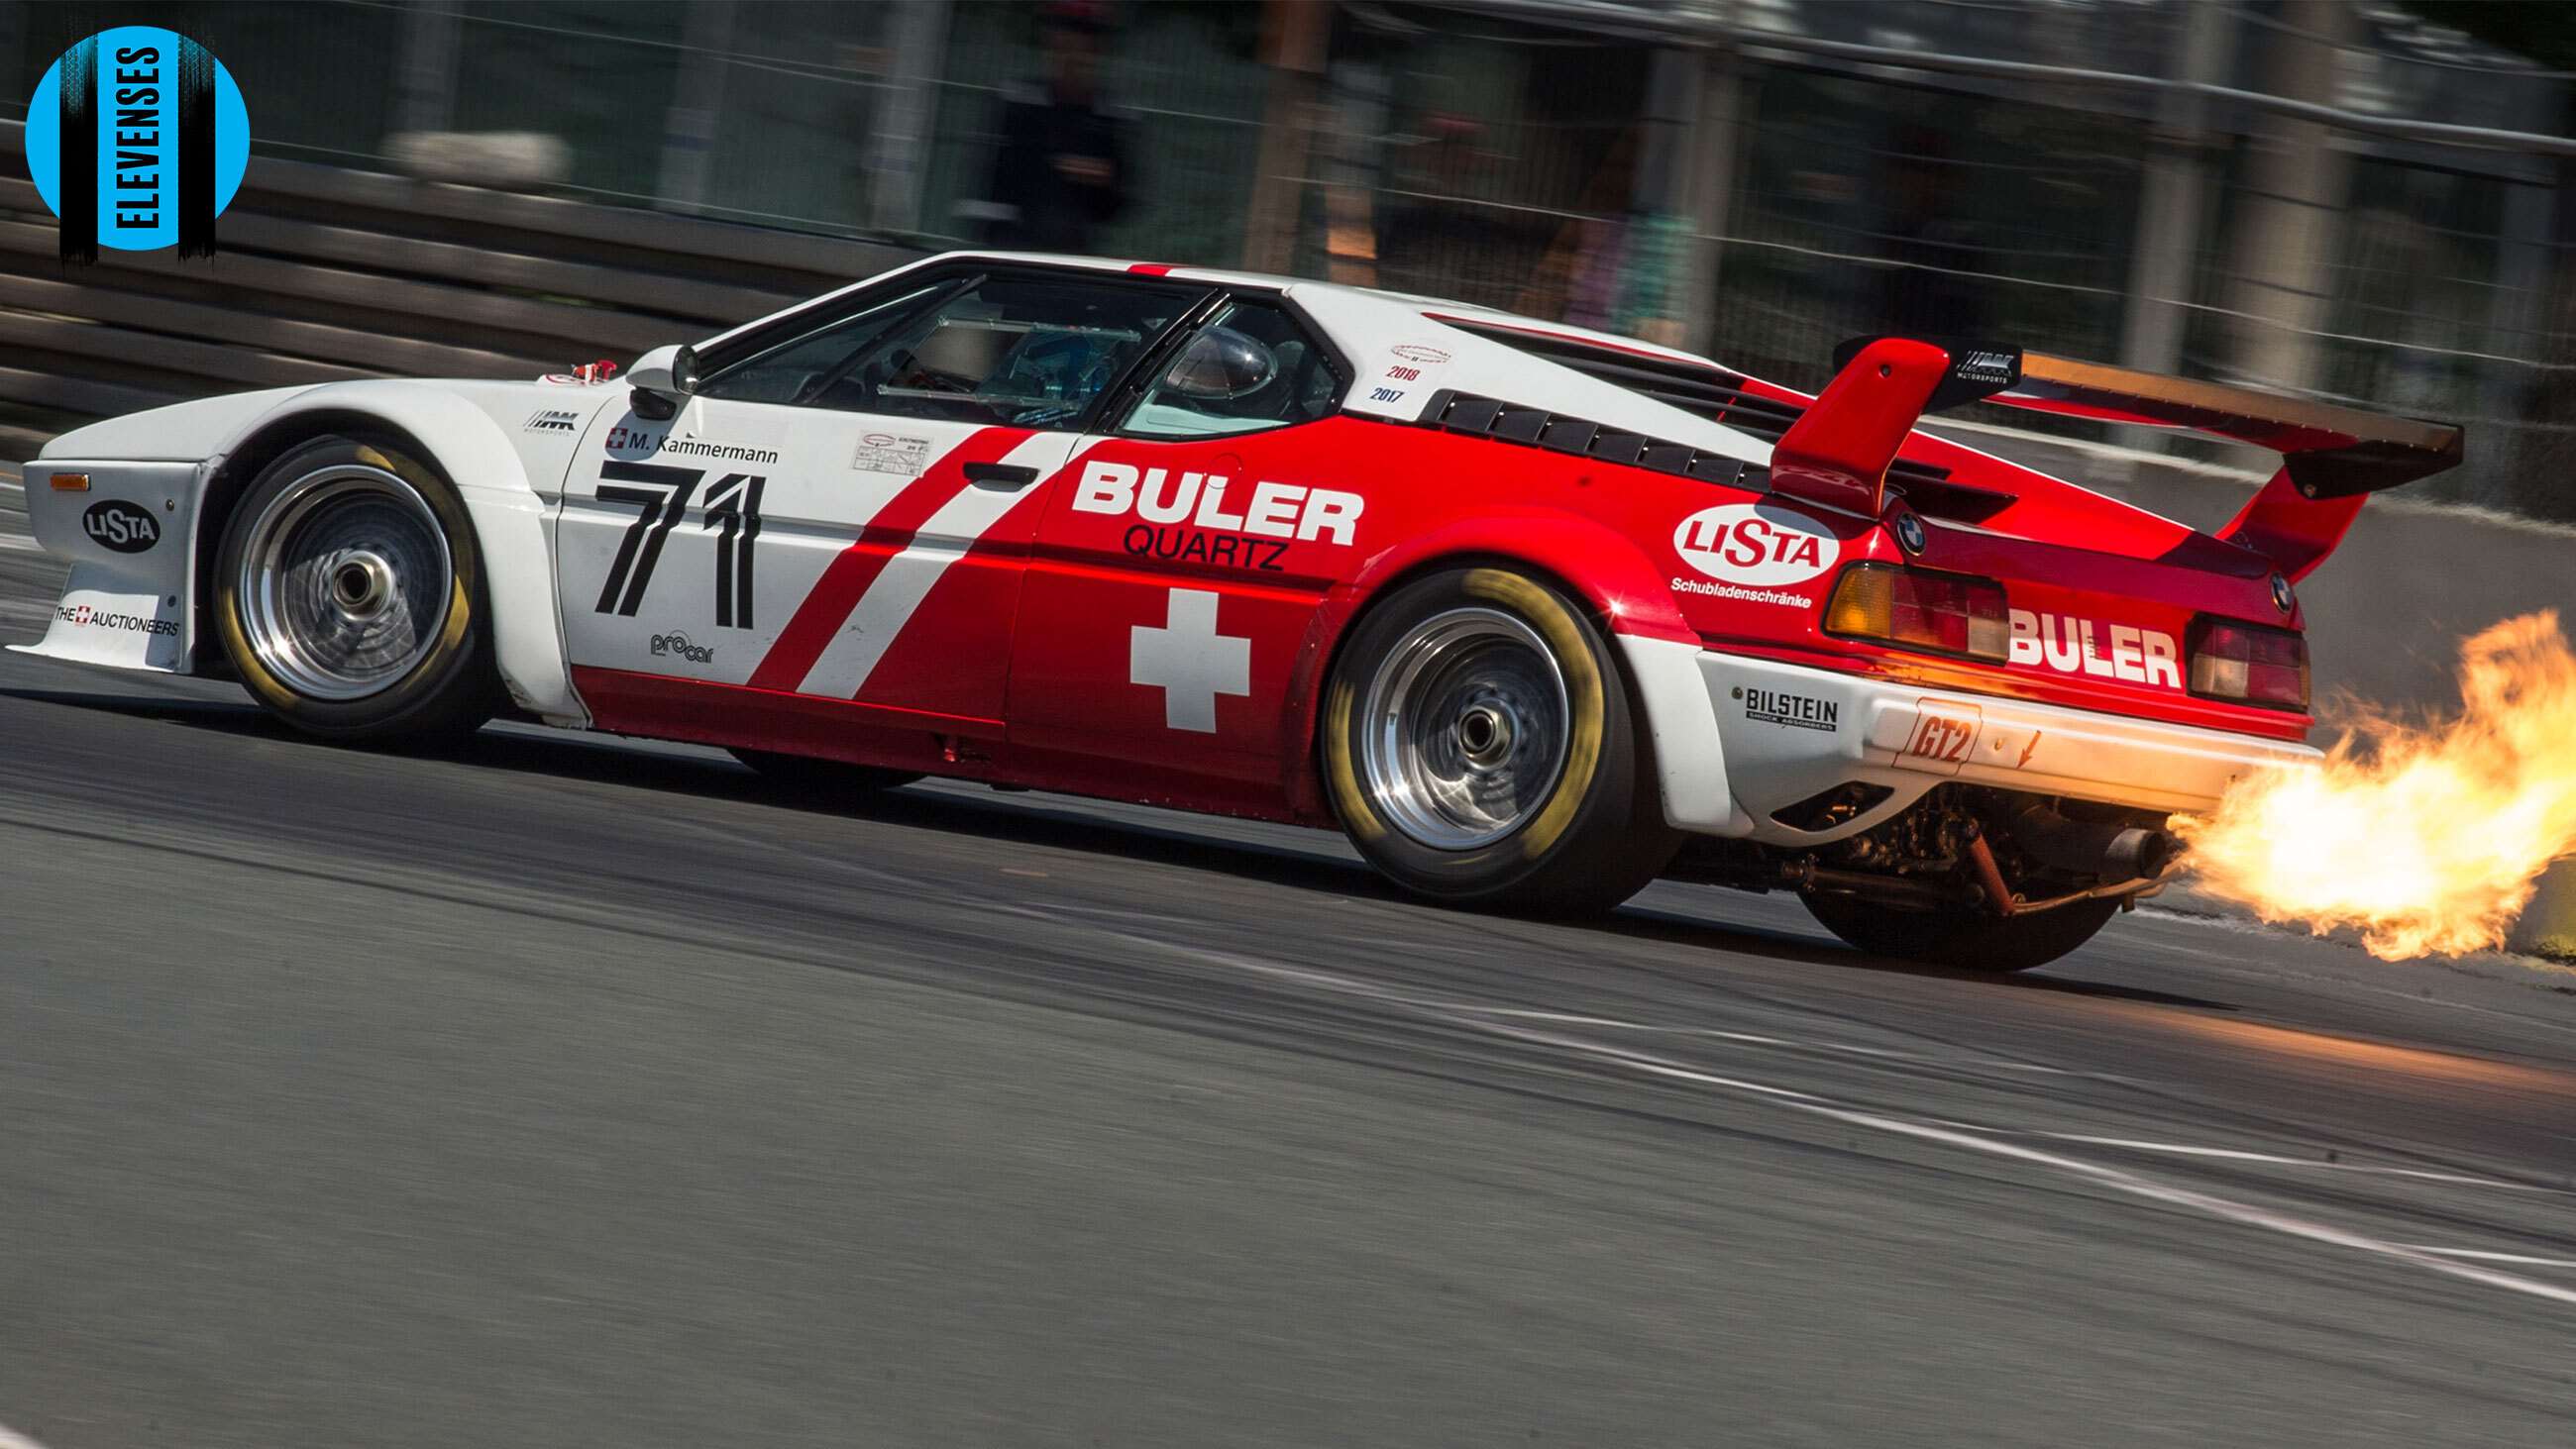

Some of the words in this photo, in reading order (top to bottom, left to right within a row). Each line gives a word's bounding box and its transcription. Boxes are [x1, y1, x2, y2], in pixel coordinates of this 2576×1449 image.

[1386, 364, 1421, 381] 2018
[1369, 387, 1405, 403] 2017
[629, 433, 650, 451] M.
[656, 435, 779, 465] Kammermann
[1071, 460, 1365, 547] BULER
[593, 459, 767, 631] 71
[1123, 524, 1289, 571] QUARTZ
[1670, 576, 1813, 609] Schubladenschränke
[55, 606, 76, 622] THE
[89, 611, 180, 637] AUCTIONEERS
[2008, 608, 2183, 689] BULER
[1746, 687, 1838, 723] BILSTEIN
[1748, 712, 1779, 723] SHOCK
[1780, 718, 1835, 732] ABSORBERS
[1911, 715, 1973, 763] GT2
